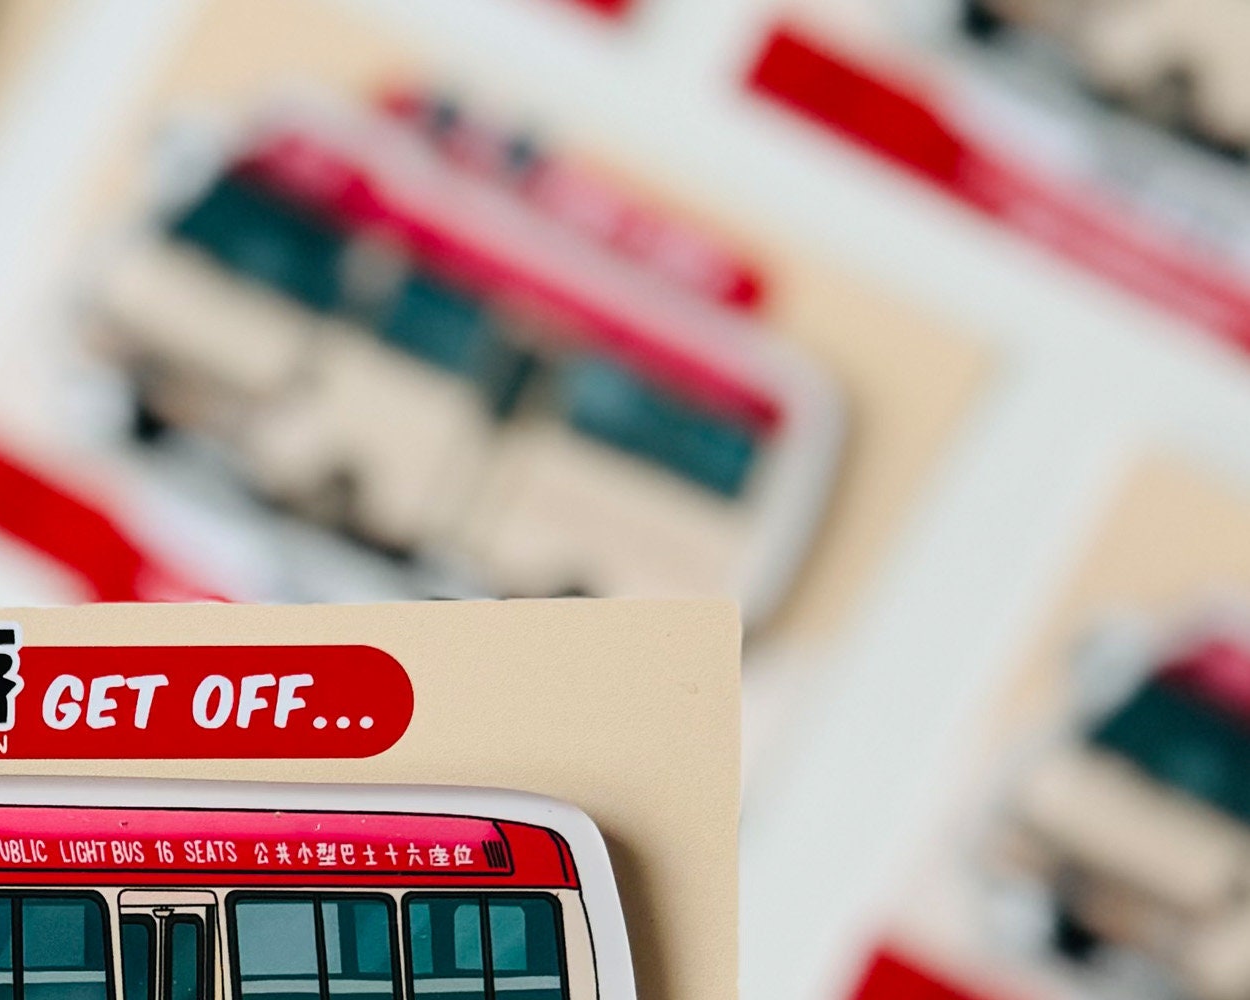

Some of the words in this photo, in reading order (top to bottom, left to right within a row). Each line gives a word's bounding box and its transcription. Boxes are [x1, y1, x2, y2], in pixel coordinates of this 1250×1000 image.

[42, 673, 169, 730] GET
[191, 673, 375, 730] OFF...
[59, 839, 107, 864] LIGHT
[111, 840, 146, 865] BUS
[154, 840, 175, 864] 16
[183, 840, 238, 864] SEATS
[253, 842, 474, 867] 公共小型巴士十六座位
